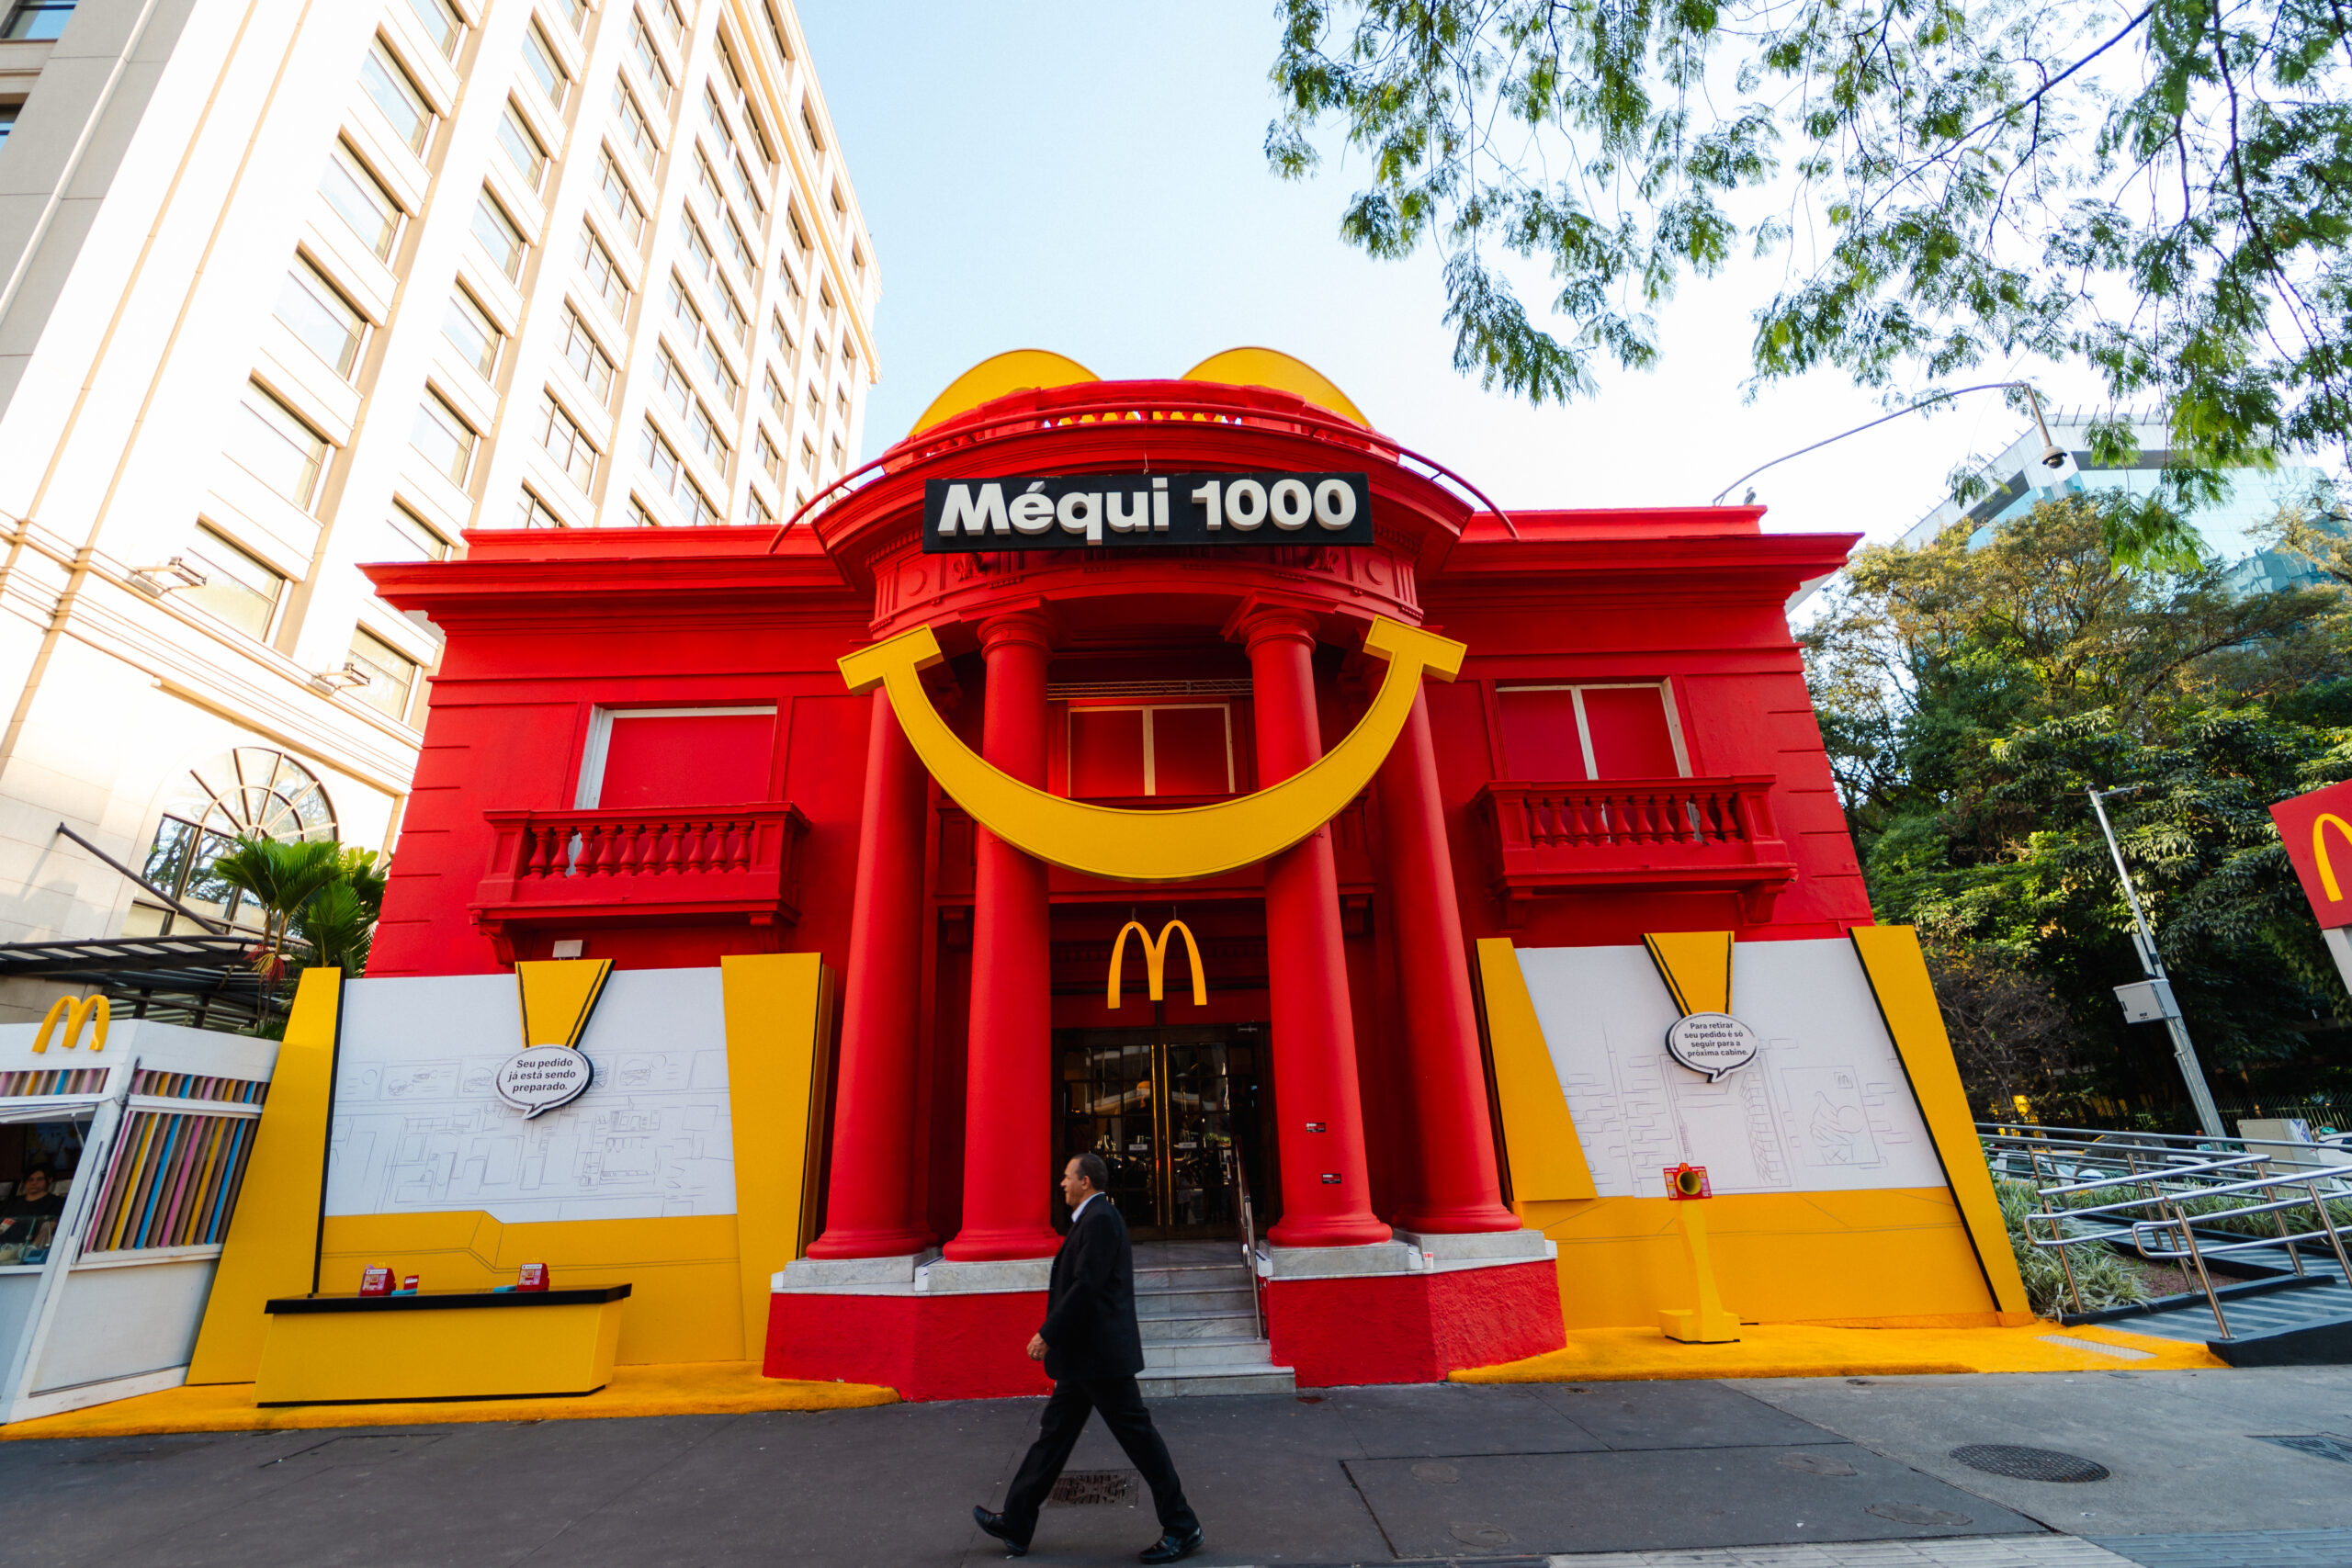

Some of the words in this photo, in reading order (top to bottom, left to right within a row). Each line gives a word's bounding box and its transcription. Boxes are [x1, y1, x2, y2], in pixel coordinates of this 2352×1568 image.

[937, 477, 1169, 546] Méqui
[1192, 478, 1358, 532] 1000
[1700, 1031, 1726, 1040] pedido
[1691, 1040, 1715, 1049] seguir
[1687, 1049, 1720, 1058] próxima
[1721, 1048, 1749, 1056] cabine.
[516, 1059, 536, 1068] Seu
[537, 1058, 573, 1069] pedido
[507, 1070, 518, 1083] já
[520, 1069, 543, 1080] está
[545, 1069, 576, 1079] sendo
[512, 1081, 568, 1094] preparado.
